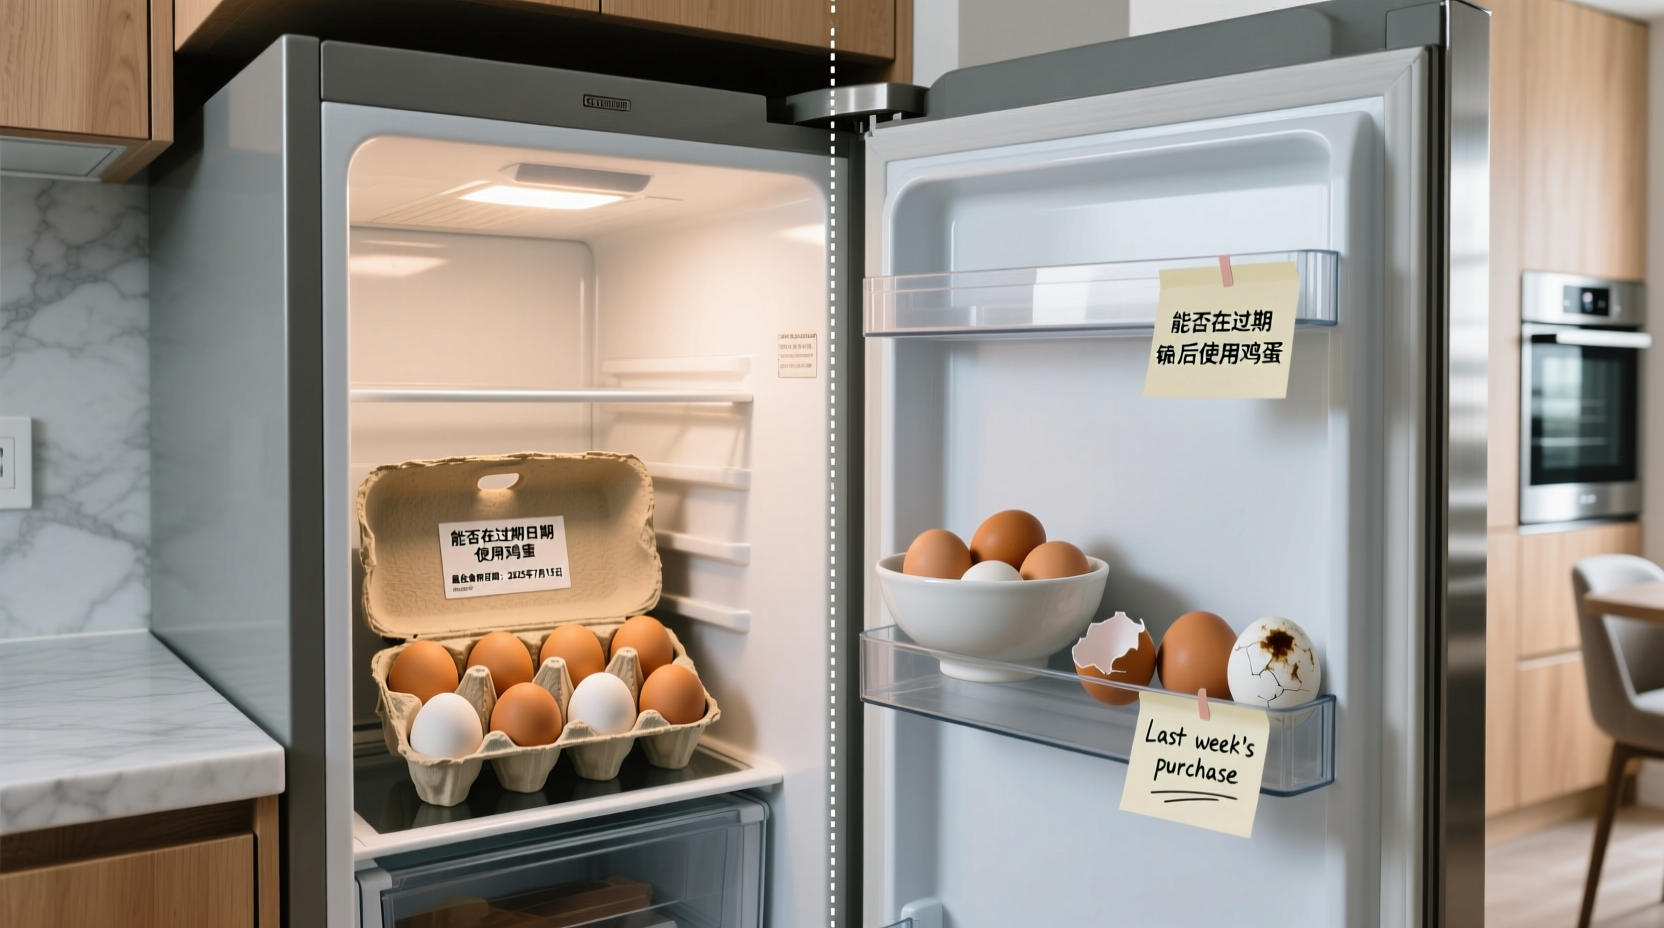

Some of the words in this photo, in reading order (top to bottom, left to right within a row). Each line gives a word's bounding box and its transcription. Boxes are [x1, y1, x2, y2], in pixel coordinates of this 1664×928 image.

[1170, 309, 1273, 334] 能否在过期
[1145, 718, 1188, 747] Last
[1195, 734, 1255, 758] week's
[1153, 757, 1238, 785] purchase
